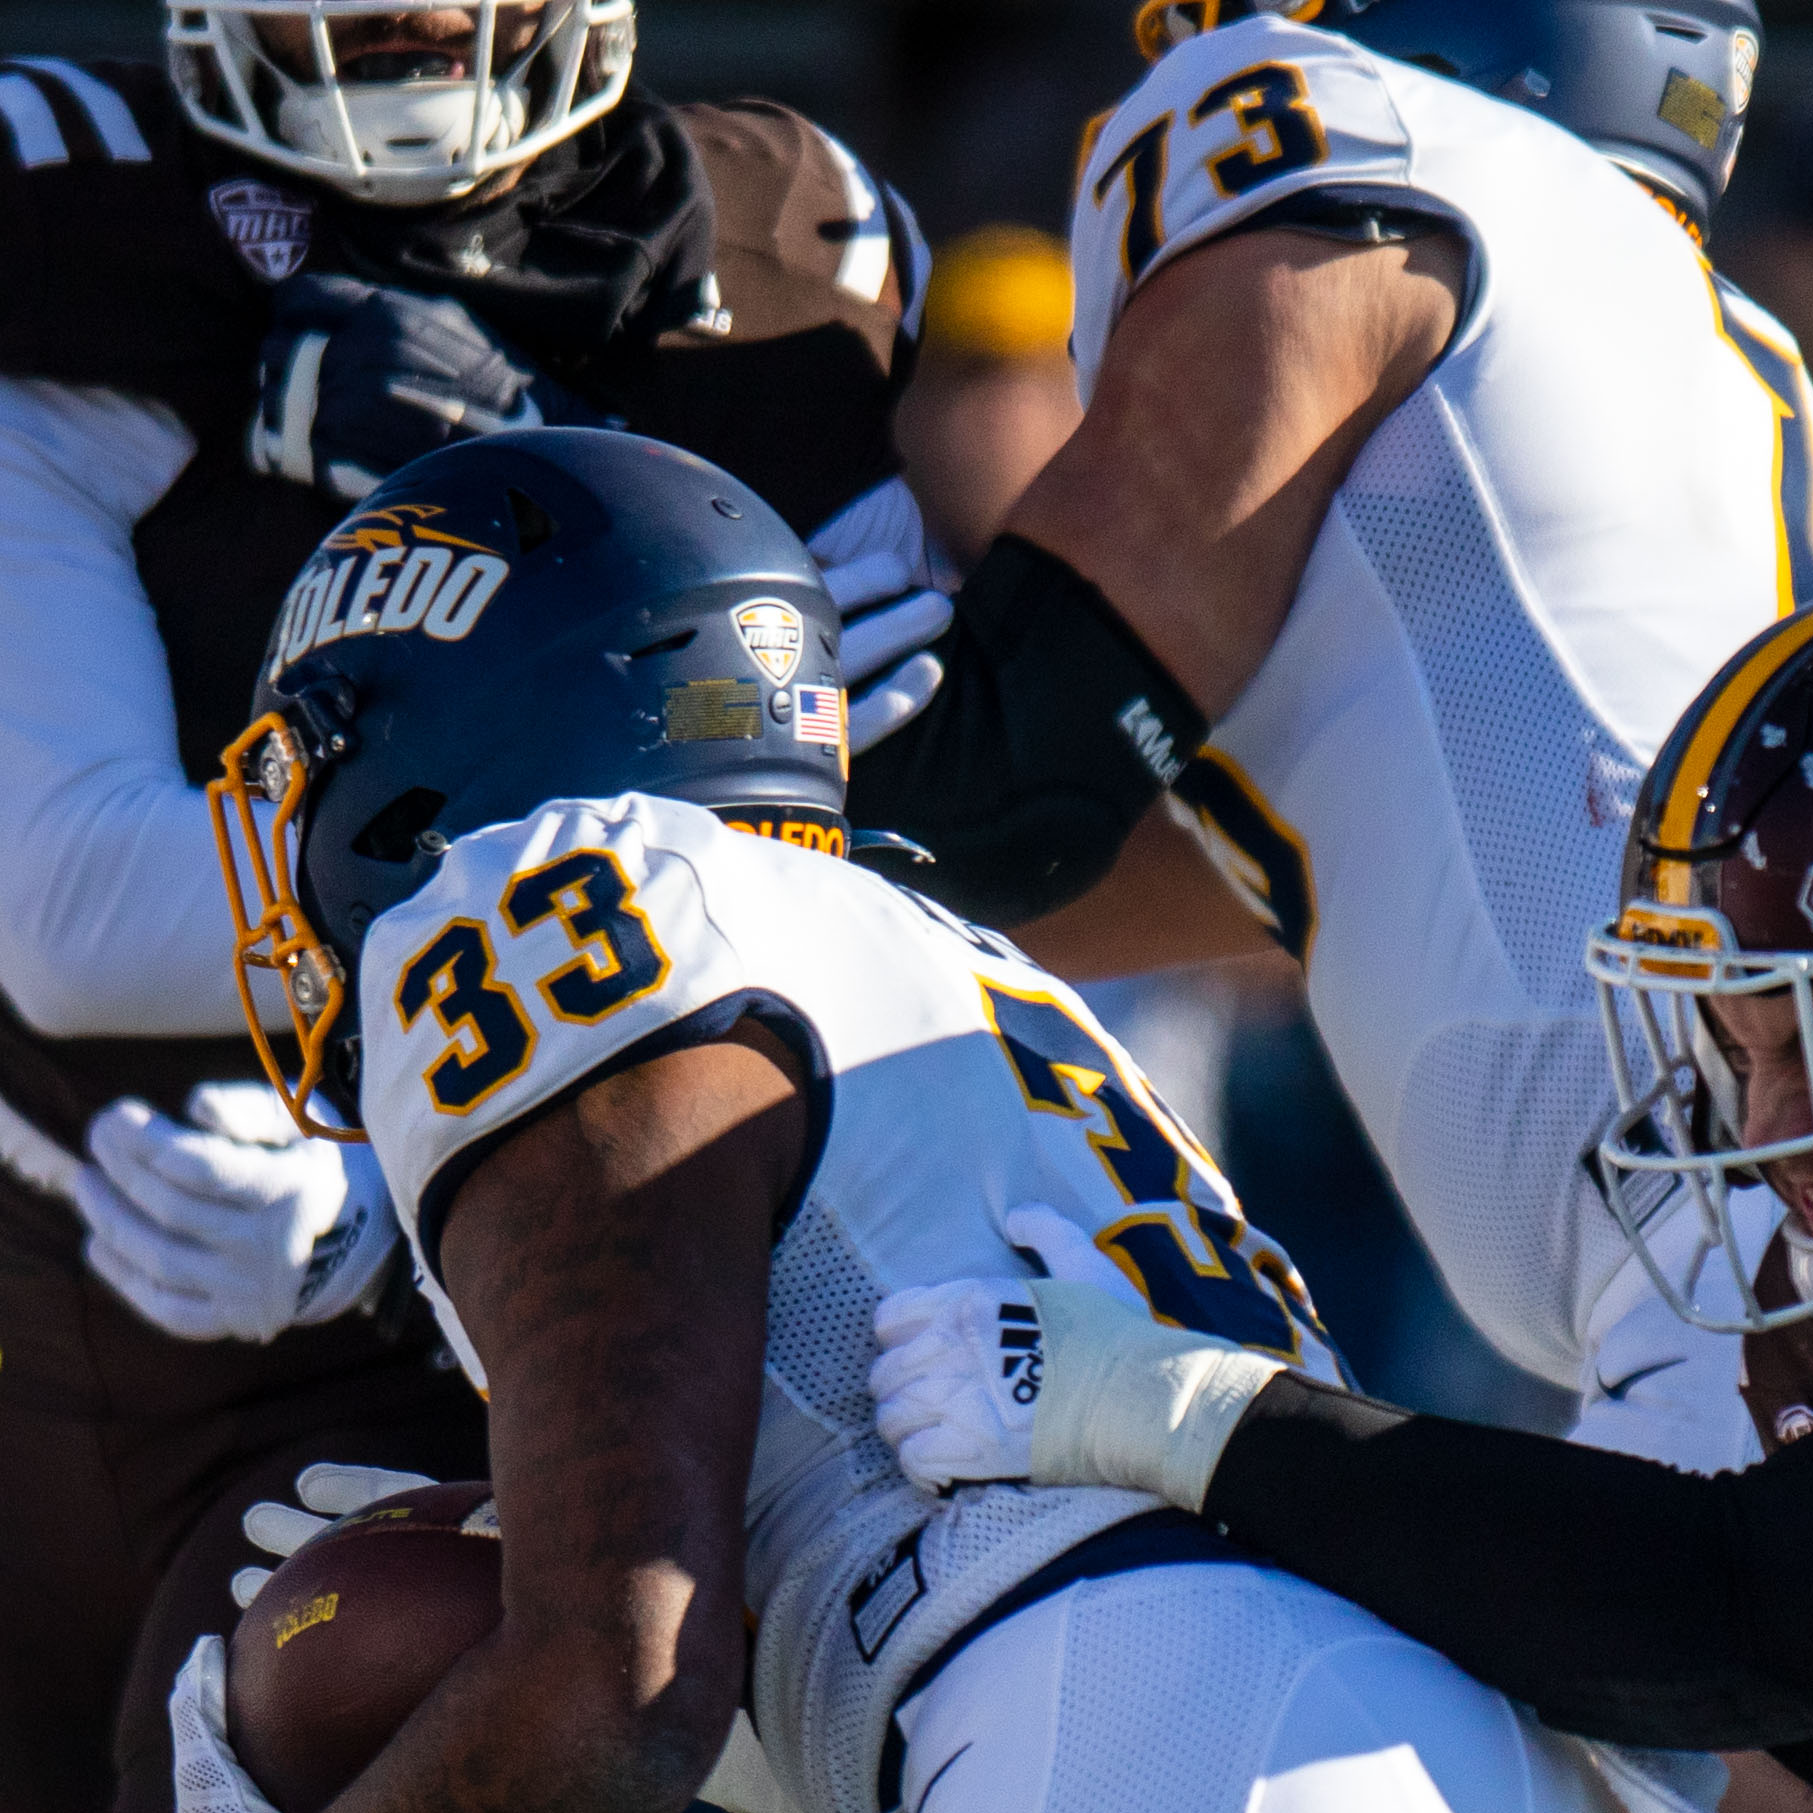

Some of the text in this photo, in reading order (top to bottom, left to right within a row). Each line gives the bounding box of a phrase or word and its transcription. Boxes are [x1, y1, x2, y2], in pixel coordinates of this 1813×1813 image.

[1093, 60, 1331, 288] 73
[745, 627, 800, 650] MAC
[394, 847, 673, 1116] 33
